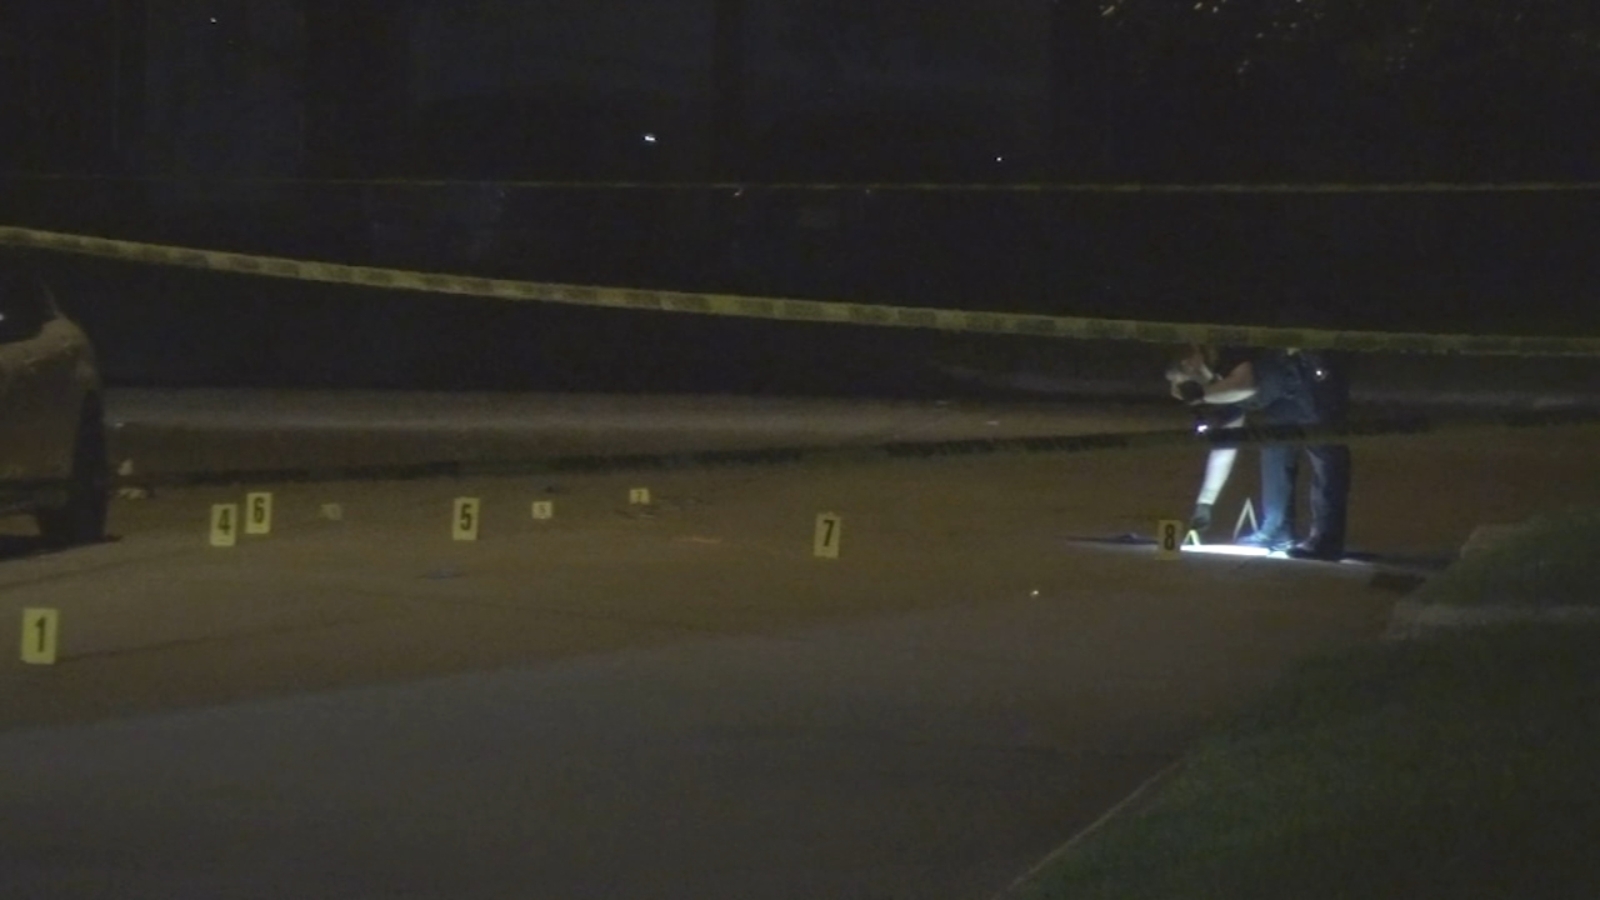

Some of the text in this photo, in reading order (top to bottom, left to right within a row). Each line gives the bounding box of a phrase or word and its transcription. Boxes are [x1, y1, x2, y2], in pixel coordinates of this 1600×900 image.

[217, 508, 230, 534] 4
[253, 497, 265, 523] 6
[460, 503, 472, 531] 5
[824, 519, 834, 547] 7
[1164, 524, 1175, 551] 8
[35, 616, 46, 653] 1
